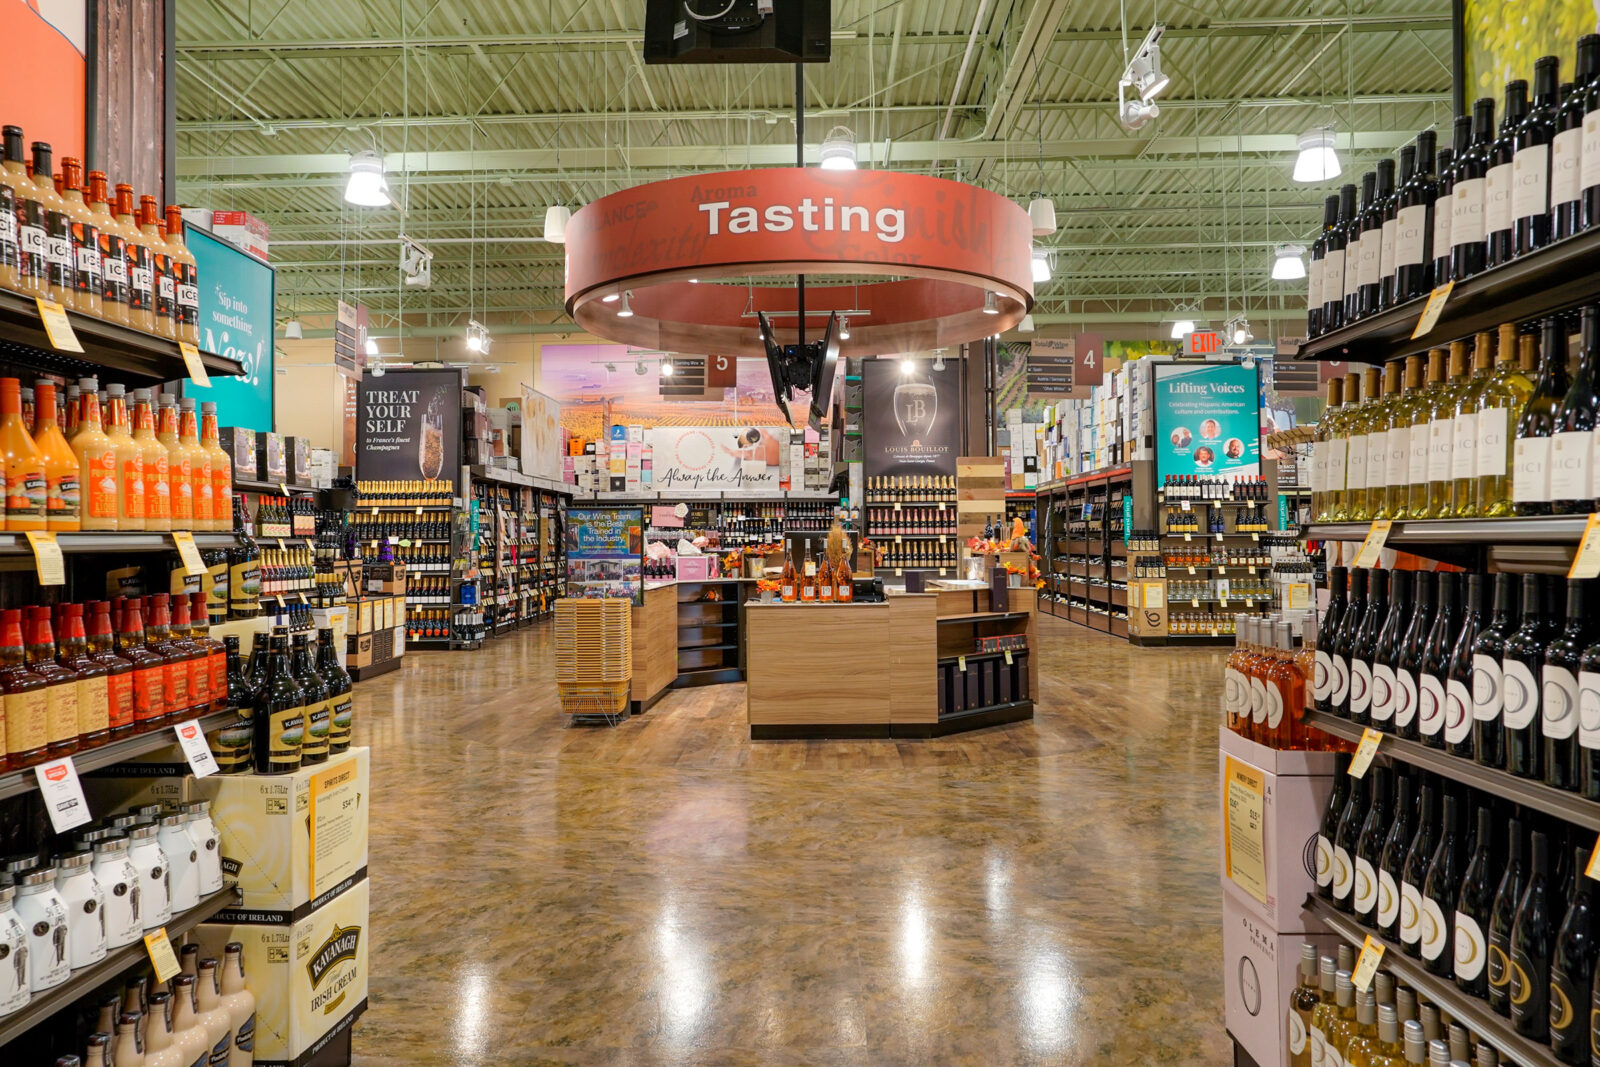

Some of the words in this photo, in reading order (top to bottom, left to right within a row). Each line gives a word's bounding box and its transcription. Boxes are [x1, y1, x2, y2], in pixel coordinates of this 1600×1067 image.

[690, 181, 757, 202] Aroma
[698, 197, 906, 243] Tasting
[181, 289, 198, 301] ICE
[217, 291, 231, 310] Sip
[232, 296, 248, 314] into
[212, 311, 253, 337] something
[358, 324, 368, 346] 10
[1191, 333, 1217, 353] EXIT
[716, 354, 728, 371] 5
[1083, 350, 1096, 369] 4
[1168, 382, 1208, 395] Lifting
[1209, 382, 1245, 394] Voices
[366, 390, 420, 404] TREAT
[366, 405, 412, 419] YOUR
[366, 420, 406, 433] SELF
[372, 436, 394, 444] France's
[395, 436, 411, 444] finest
[366, 444, 400, 452] Champagnes
[884, 446, 908, 454] LOUIS
[657, 467, 705, 488] Always
[706, 467, 728, 483] the
[727, 467, 773, 488] Answer
[586, 520, 593, 528] is
[588, 527, 613, 535] Trained
[614, 527, 622, 535] in
[596, 535, 625, 544] Industry
[140, 767, 176, 775] IRELAND
[338, 771, 350, 783] DIRECT
[261, 785, 265, 794] 6
[311, 892, 330, 910] PRODUCT
[335, 879, 353, 894] IRELAND
[237, 913, 248, 922] OF
[249, 914, 284, 922] IRELAND
[261, 933, 265, 943] 6
[1243, 918, 1274, 952] OLEMA
[313, 934, 357, 978] KAVANAGH
[311, 987, 333, 1012] IRISH
[334, 966, 357, 995] CREAM
[312, 1035, 331, 1055] PRODUCT
[336, 1014, 354, 1034] IRELAND
